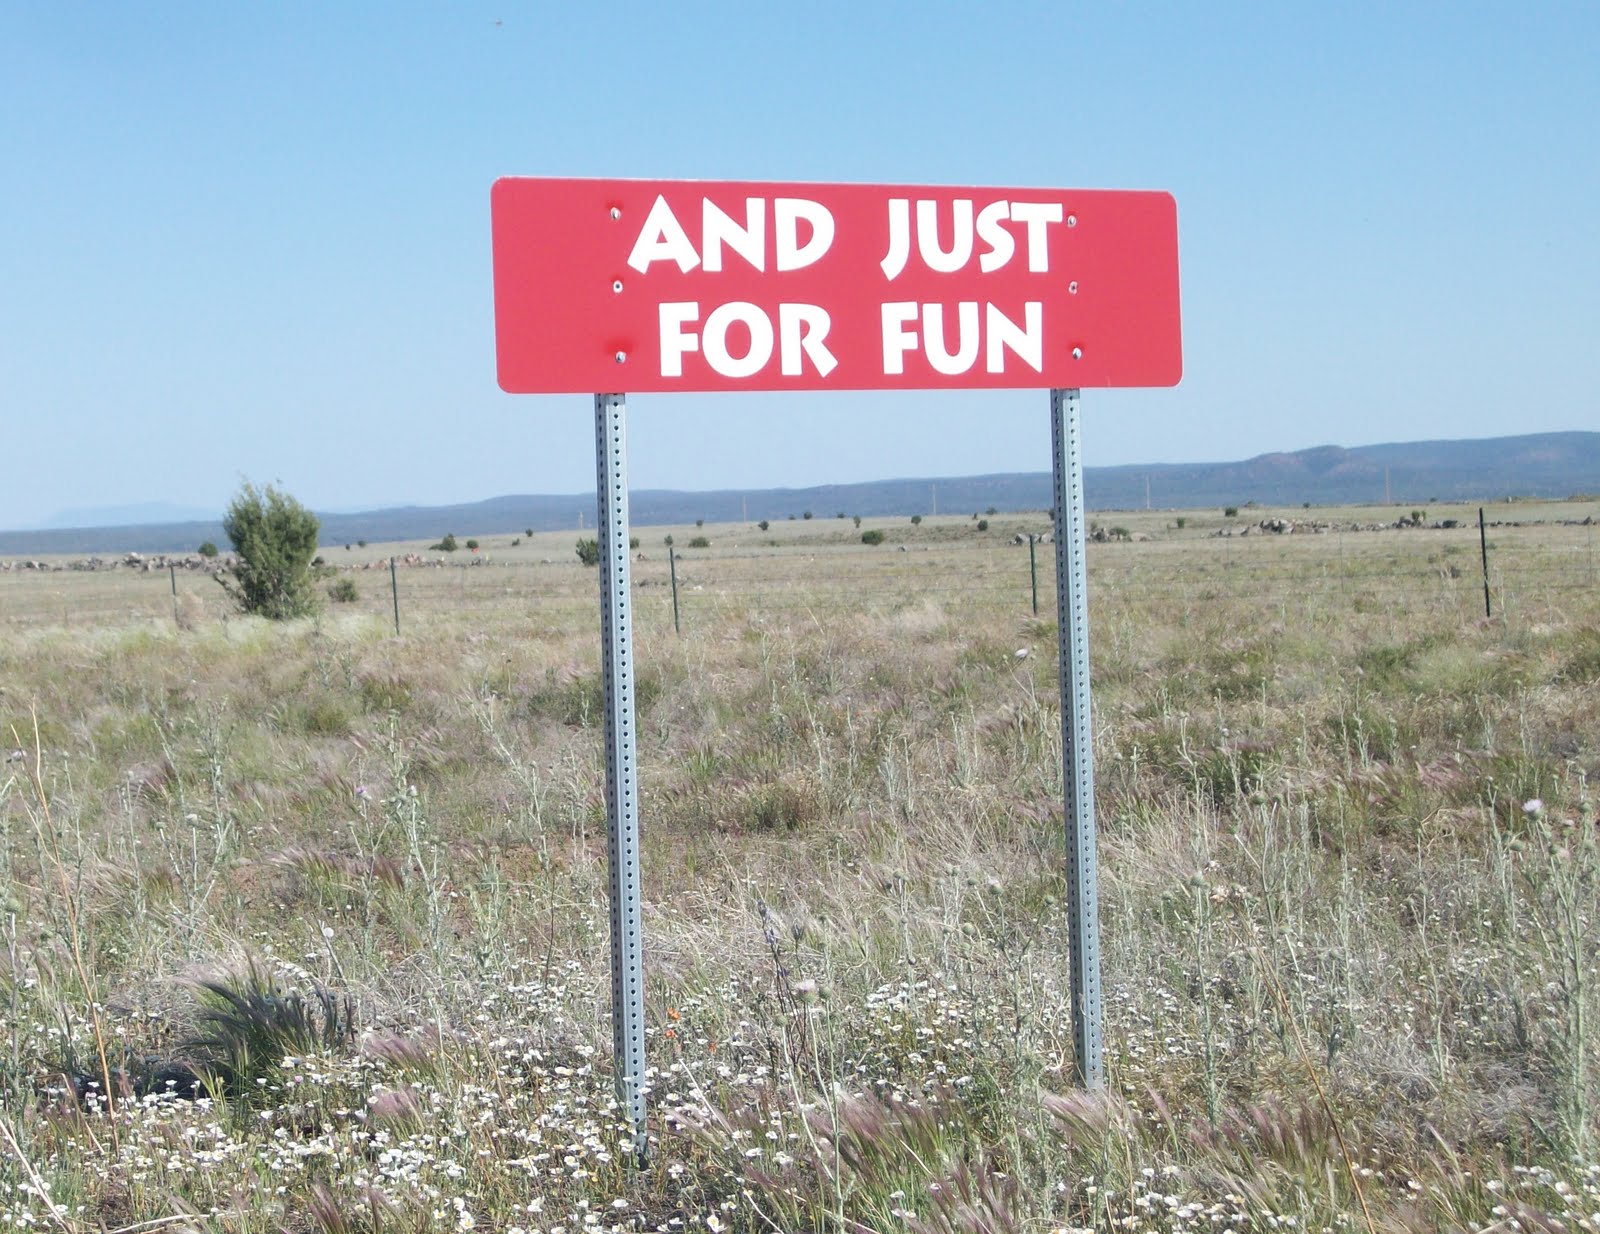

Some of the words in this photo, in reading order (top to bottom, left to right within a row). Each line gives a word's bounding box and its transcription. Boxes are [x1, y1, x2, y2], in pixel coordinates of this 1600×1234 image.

[627, 194, 835, 275] AND
[880, 198, 1063, 281] JUST
[658, 301, 839, 378] FOR
[881, 301, 1044, 376] FUN
